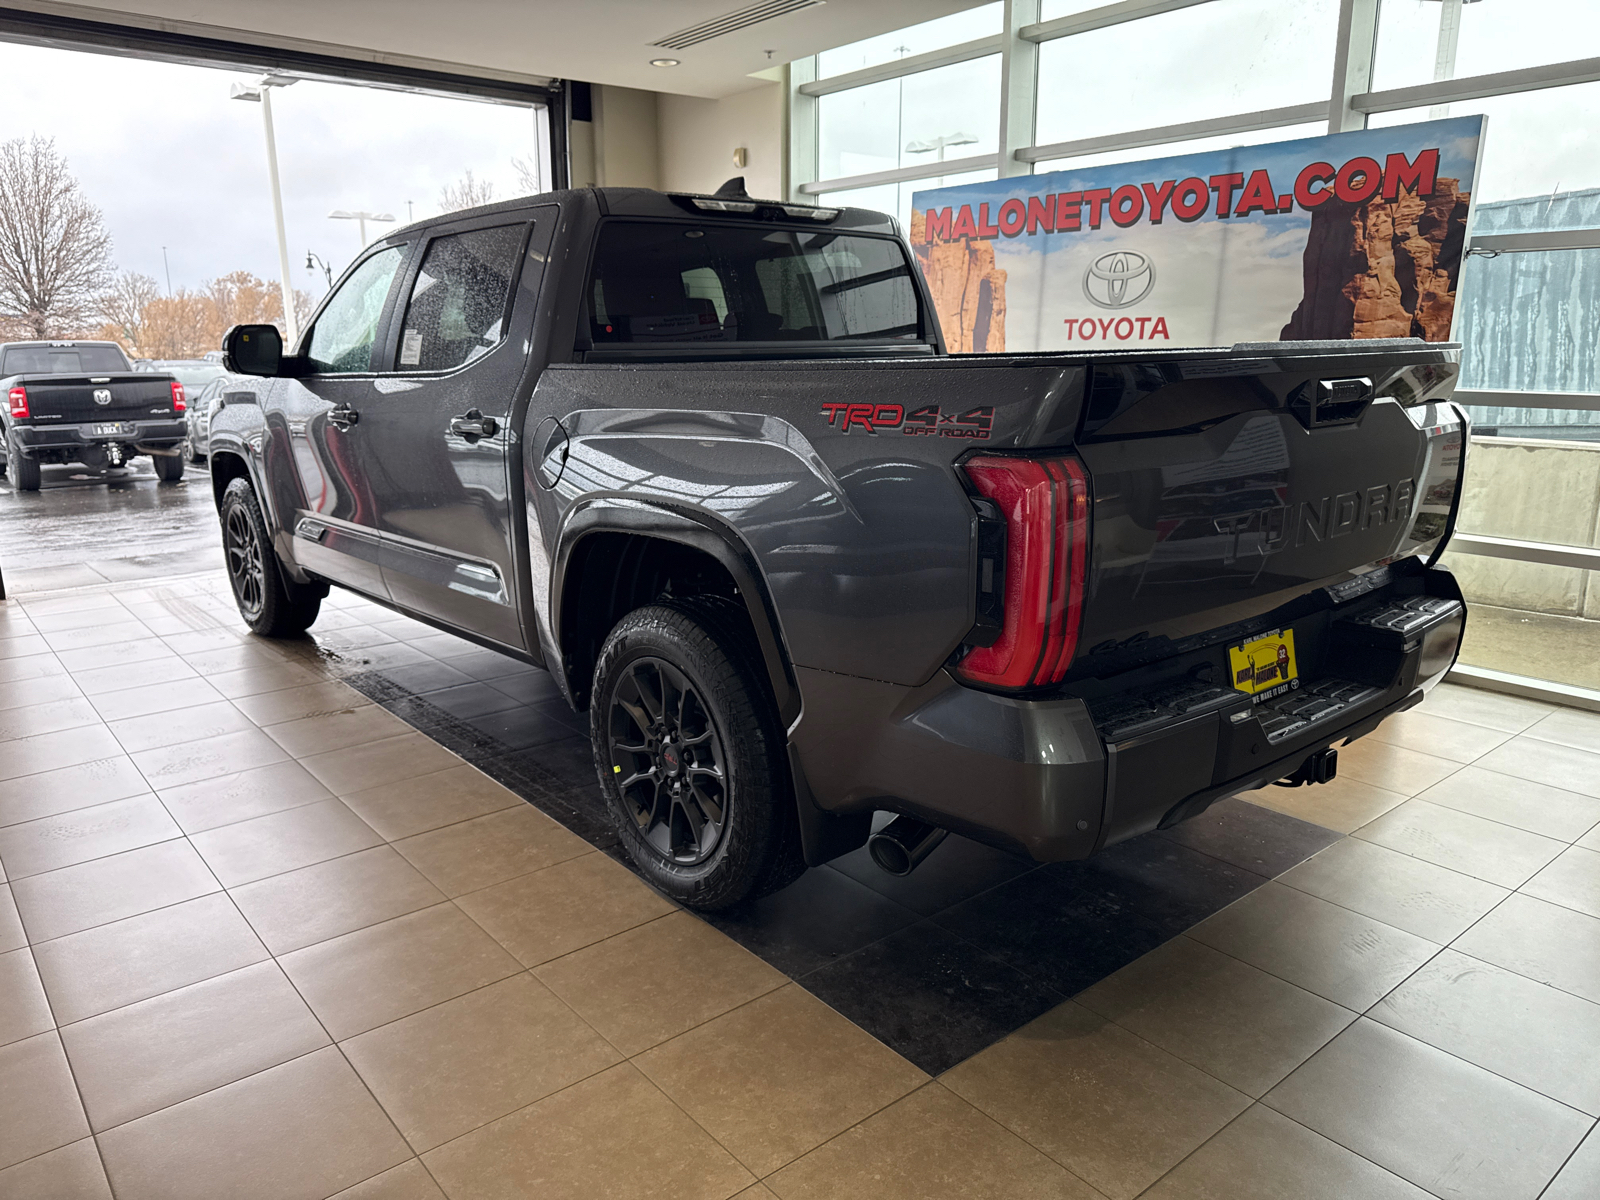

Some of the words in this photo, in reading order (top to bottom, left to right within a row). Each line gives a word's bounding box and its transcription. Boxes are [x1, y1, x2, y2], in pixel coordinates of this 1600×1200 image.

[924, 148, 1440, 244] MALONETOYOTA.COM
[1063, 317, 1171, 342] TOYOTA
[820, 402, 905, 437] TRD
[902, 427, 937, 437] OFF
[938, 428, 992, 440] ROAD
[1213, 477, 1415, 565] TUNDRA
[1278, 648, 1286, 659] 32
[1251, 695, 1260, 704] WE
[1260, 689, 1273, 702] MAKE
[1272, 687, 1279, 696] IT
[1278, 683, 1289, 695] EASY
